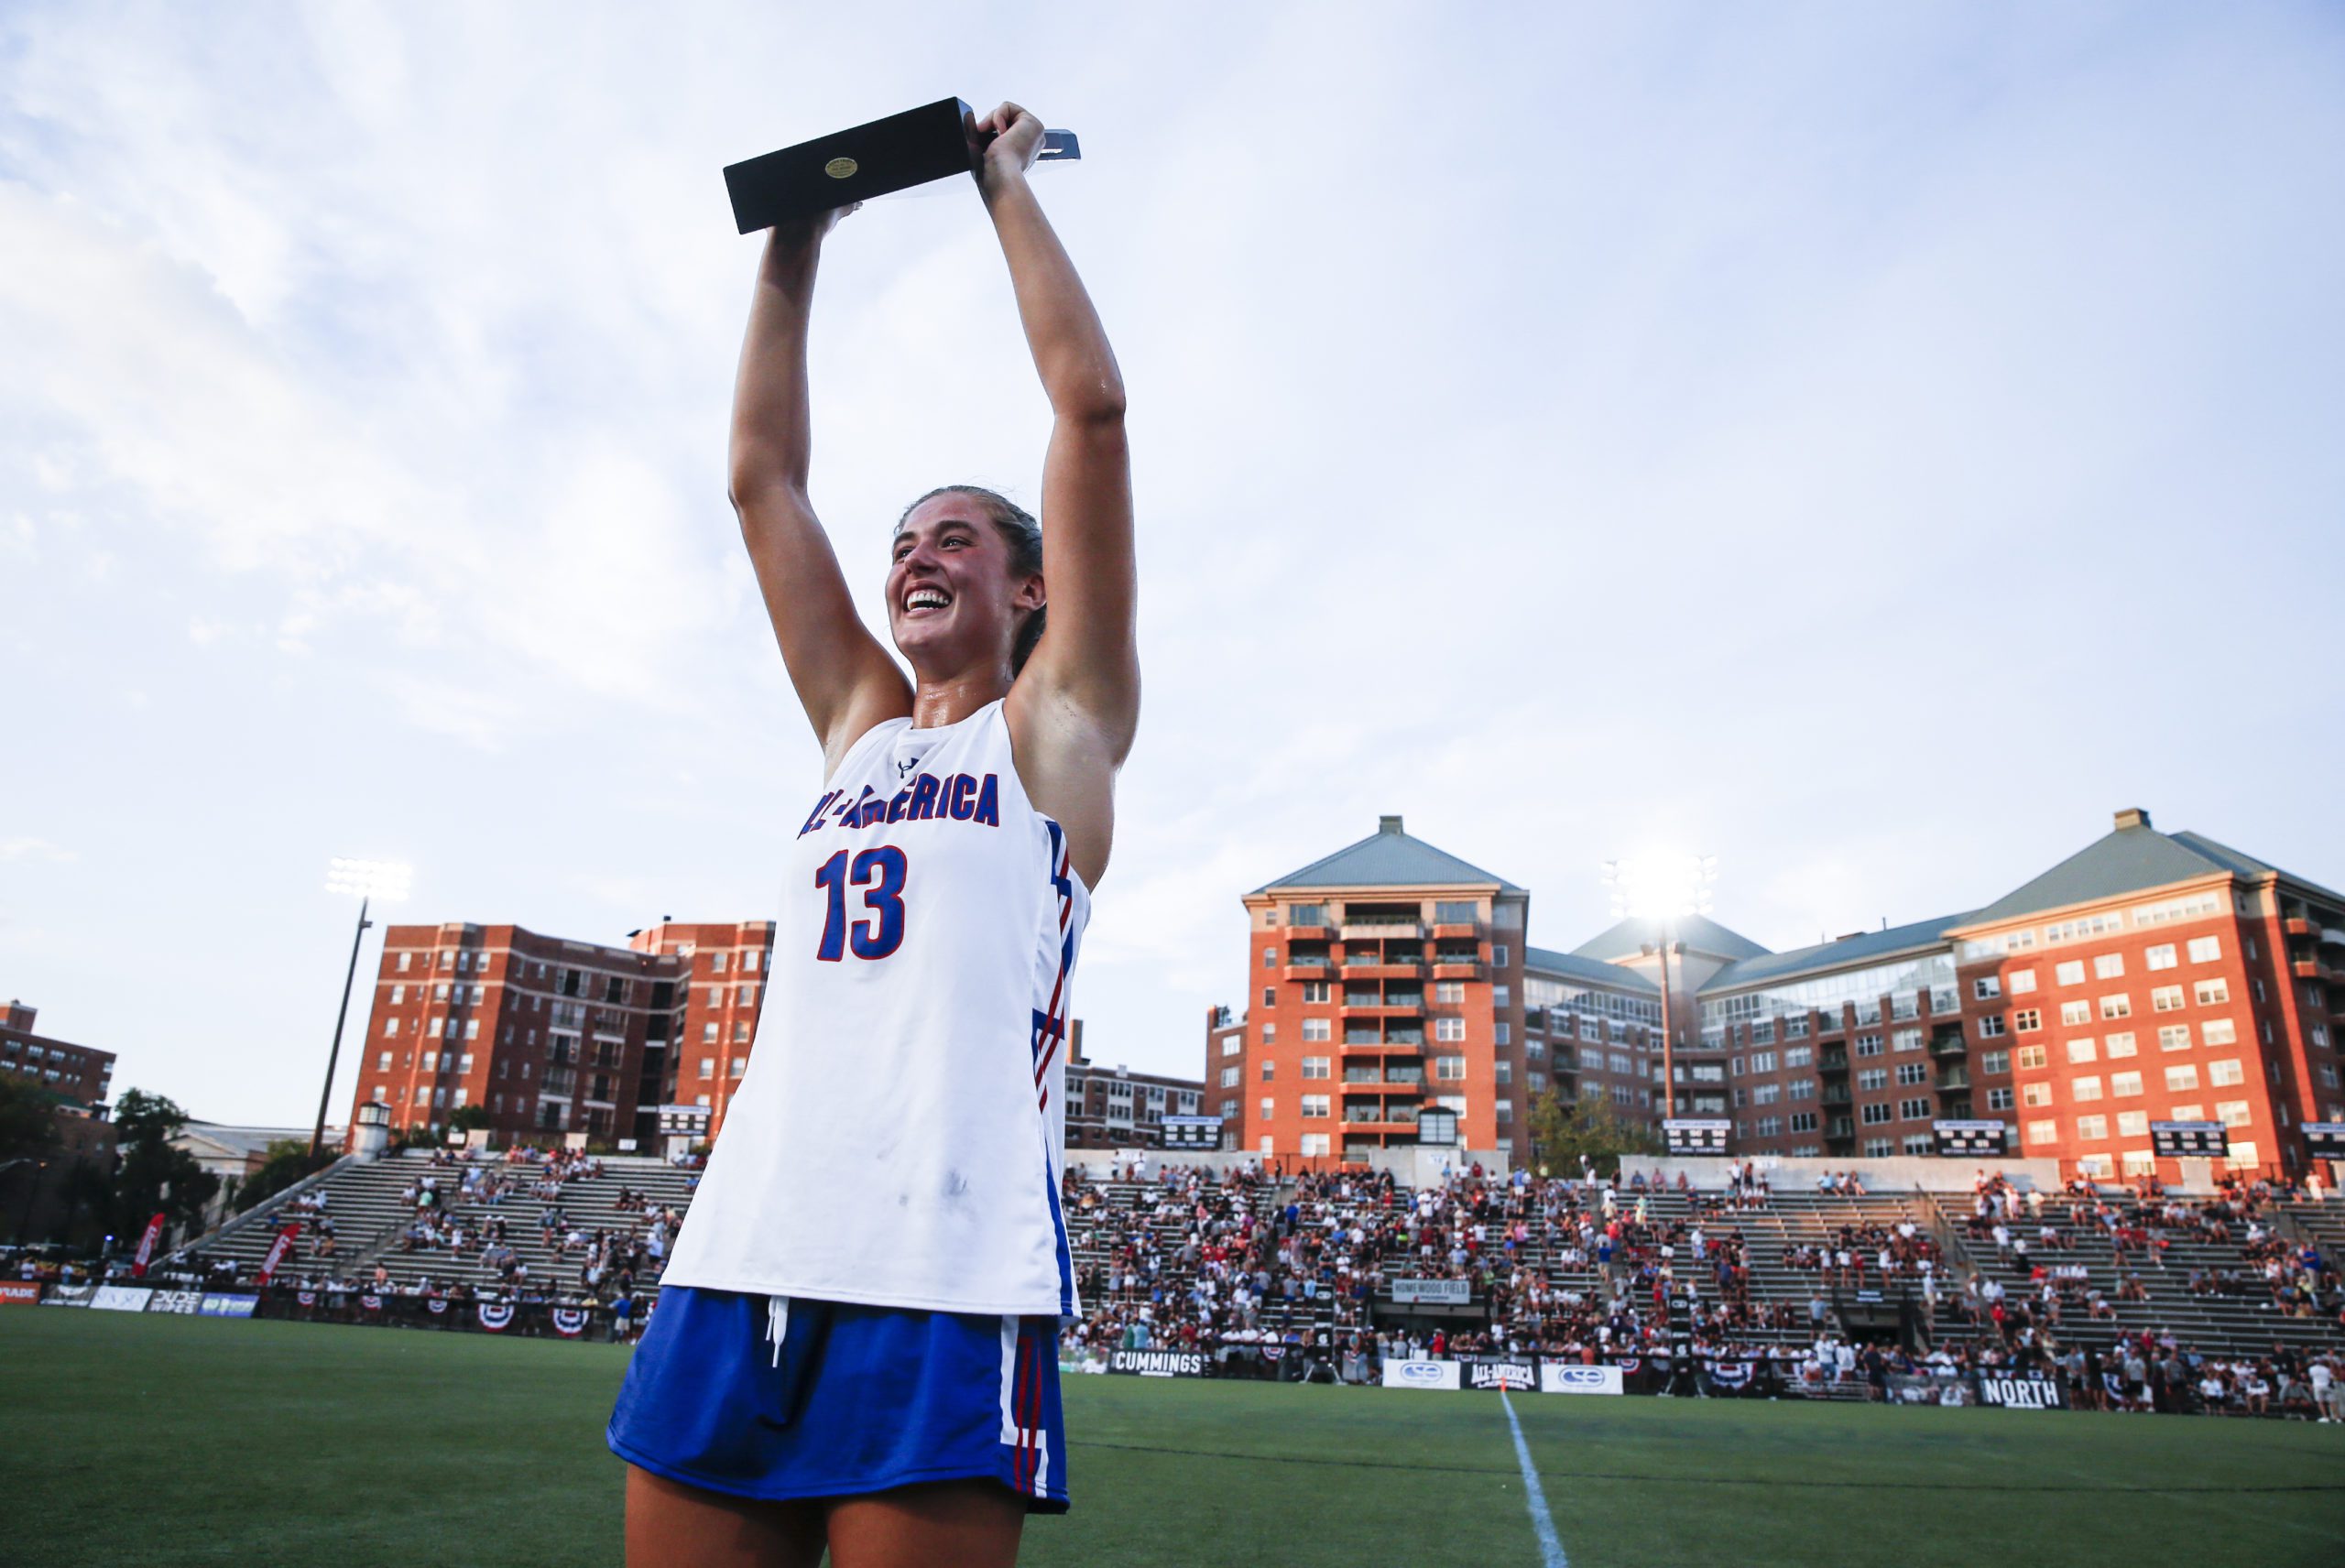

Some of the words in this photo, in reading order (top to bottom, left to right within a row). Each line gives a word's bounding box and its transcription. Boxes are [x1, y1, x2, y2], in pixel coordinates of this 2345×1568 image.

[815, 844, 908, 963] 13
[1445, 1283, 1467, 1295] FIELD
[1115, 1351, 1202, 1374] CUMMINGS
[1470, 1363, 1536, 1387] ALL-AMERICA
[1983, 1378, 2060, 1406] NORTH
